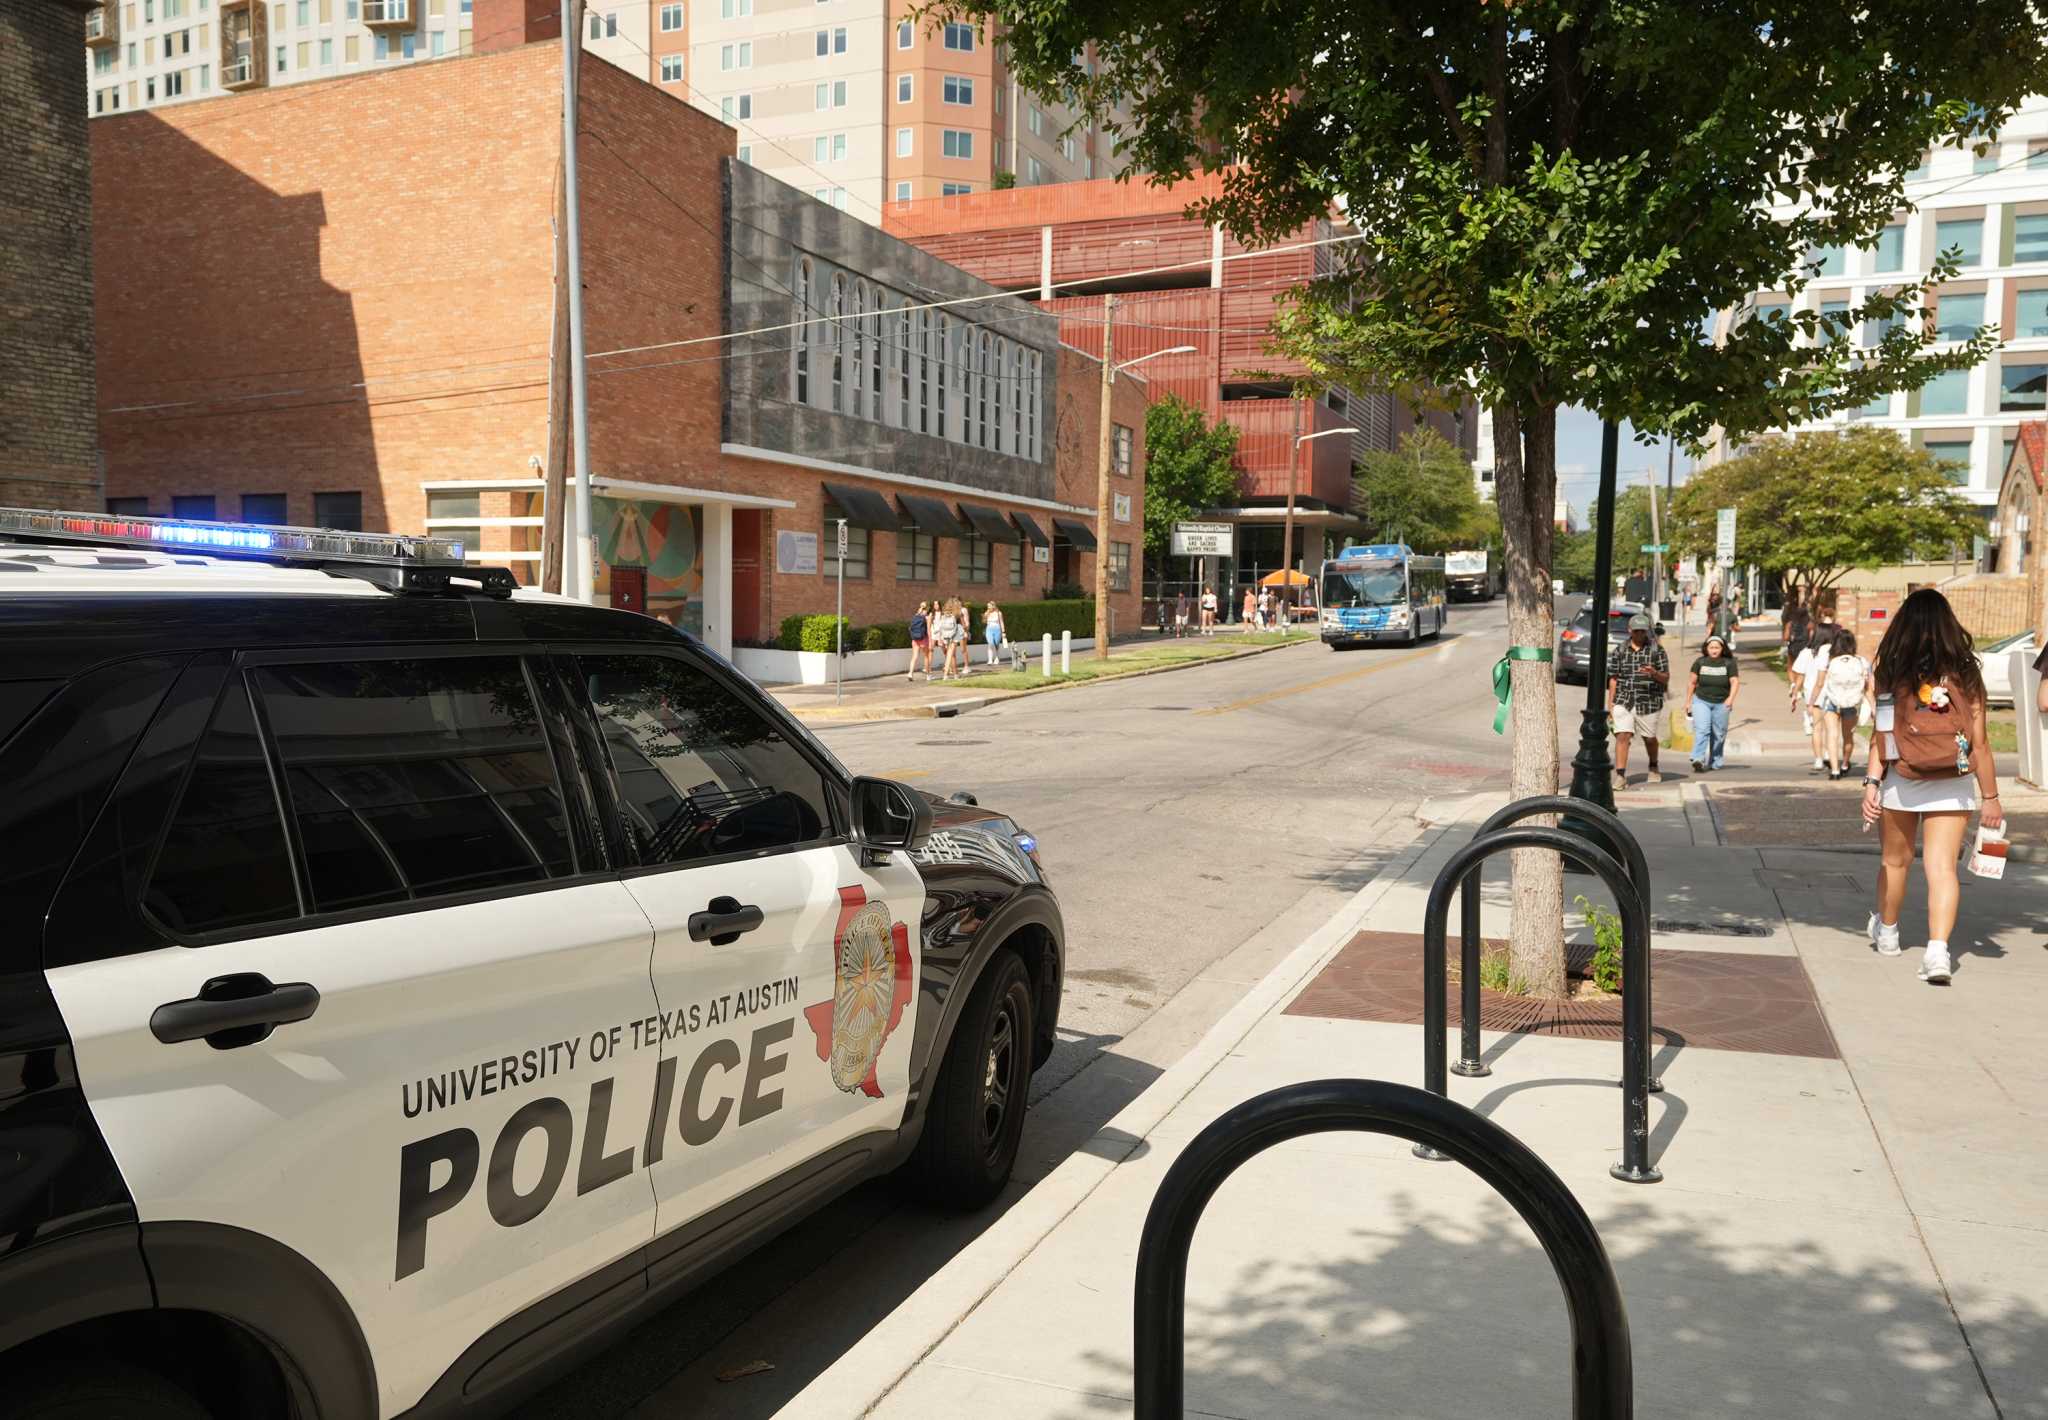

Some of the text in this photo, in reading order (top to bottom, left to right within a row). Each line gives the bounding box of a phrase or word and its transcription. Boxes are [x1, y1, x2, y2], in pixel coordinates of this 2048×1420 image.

[921, 832, 963, 864] 4195
[402, 976, 798, 1118] UNIVERSITY OF TEXAS AT AUSTIN
[395, 1017, 795, 1282] POLICE
